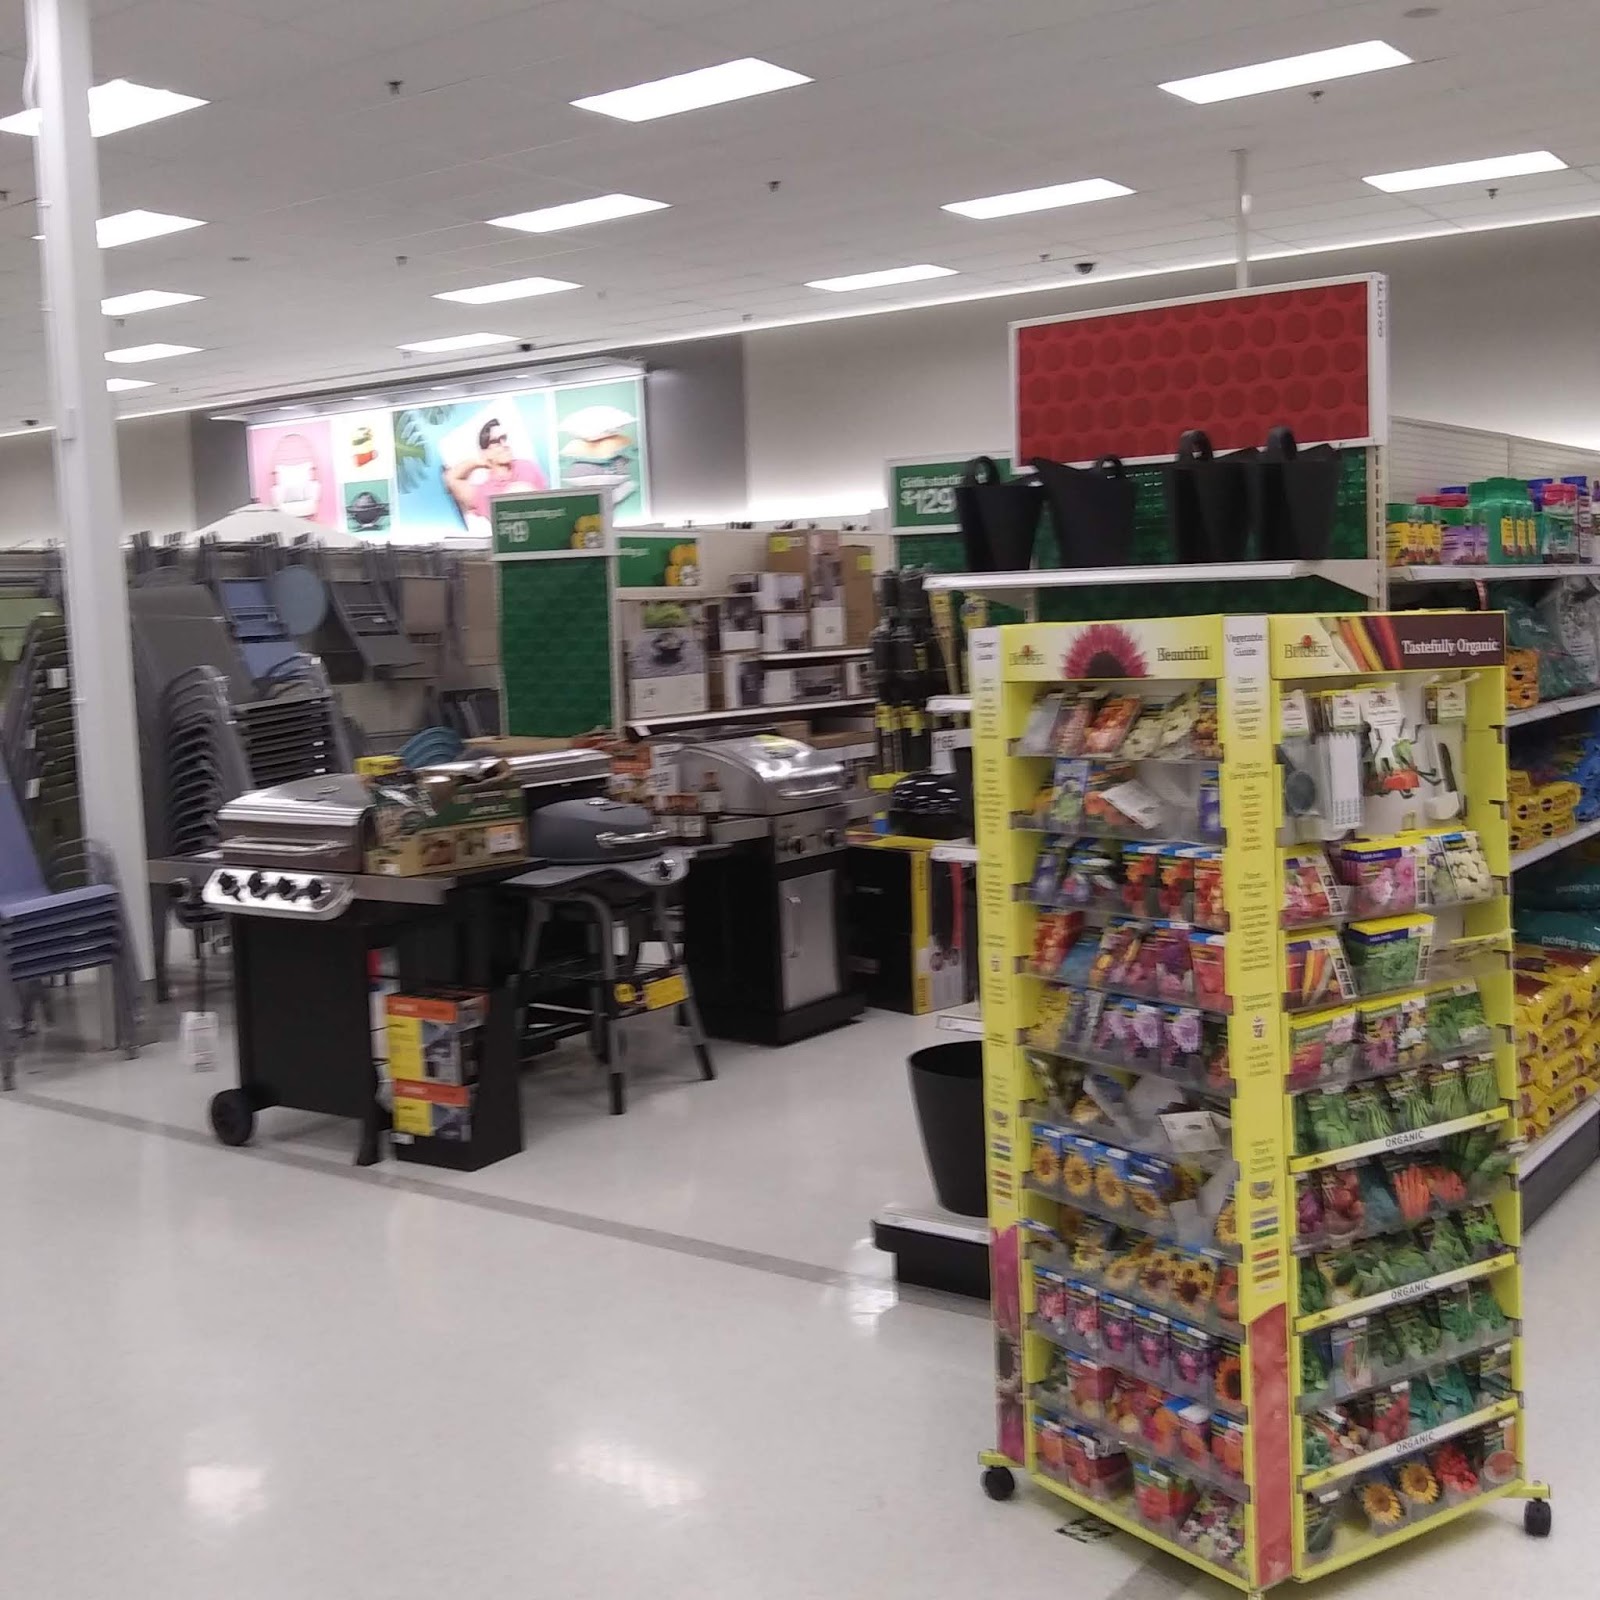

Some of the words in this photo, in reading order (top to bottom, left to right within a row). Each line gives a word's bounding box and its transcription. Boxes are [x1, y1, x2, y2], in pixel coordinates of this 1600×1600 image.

[900, 488, 957, 515] $129
[1156, 645, 1210, 662] Beautiful
[1401, 639, 1456, 657] Tastefully
[1456, 637, 1500, 656] Organic
[1384, 1130, 1425, 1149] ORGANIC
[1390, 1280, 1432, 1301] ORGANIC
[1395, 1431, 1436, 1453] ORGANIC
